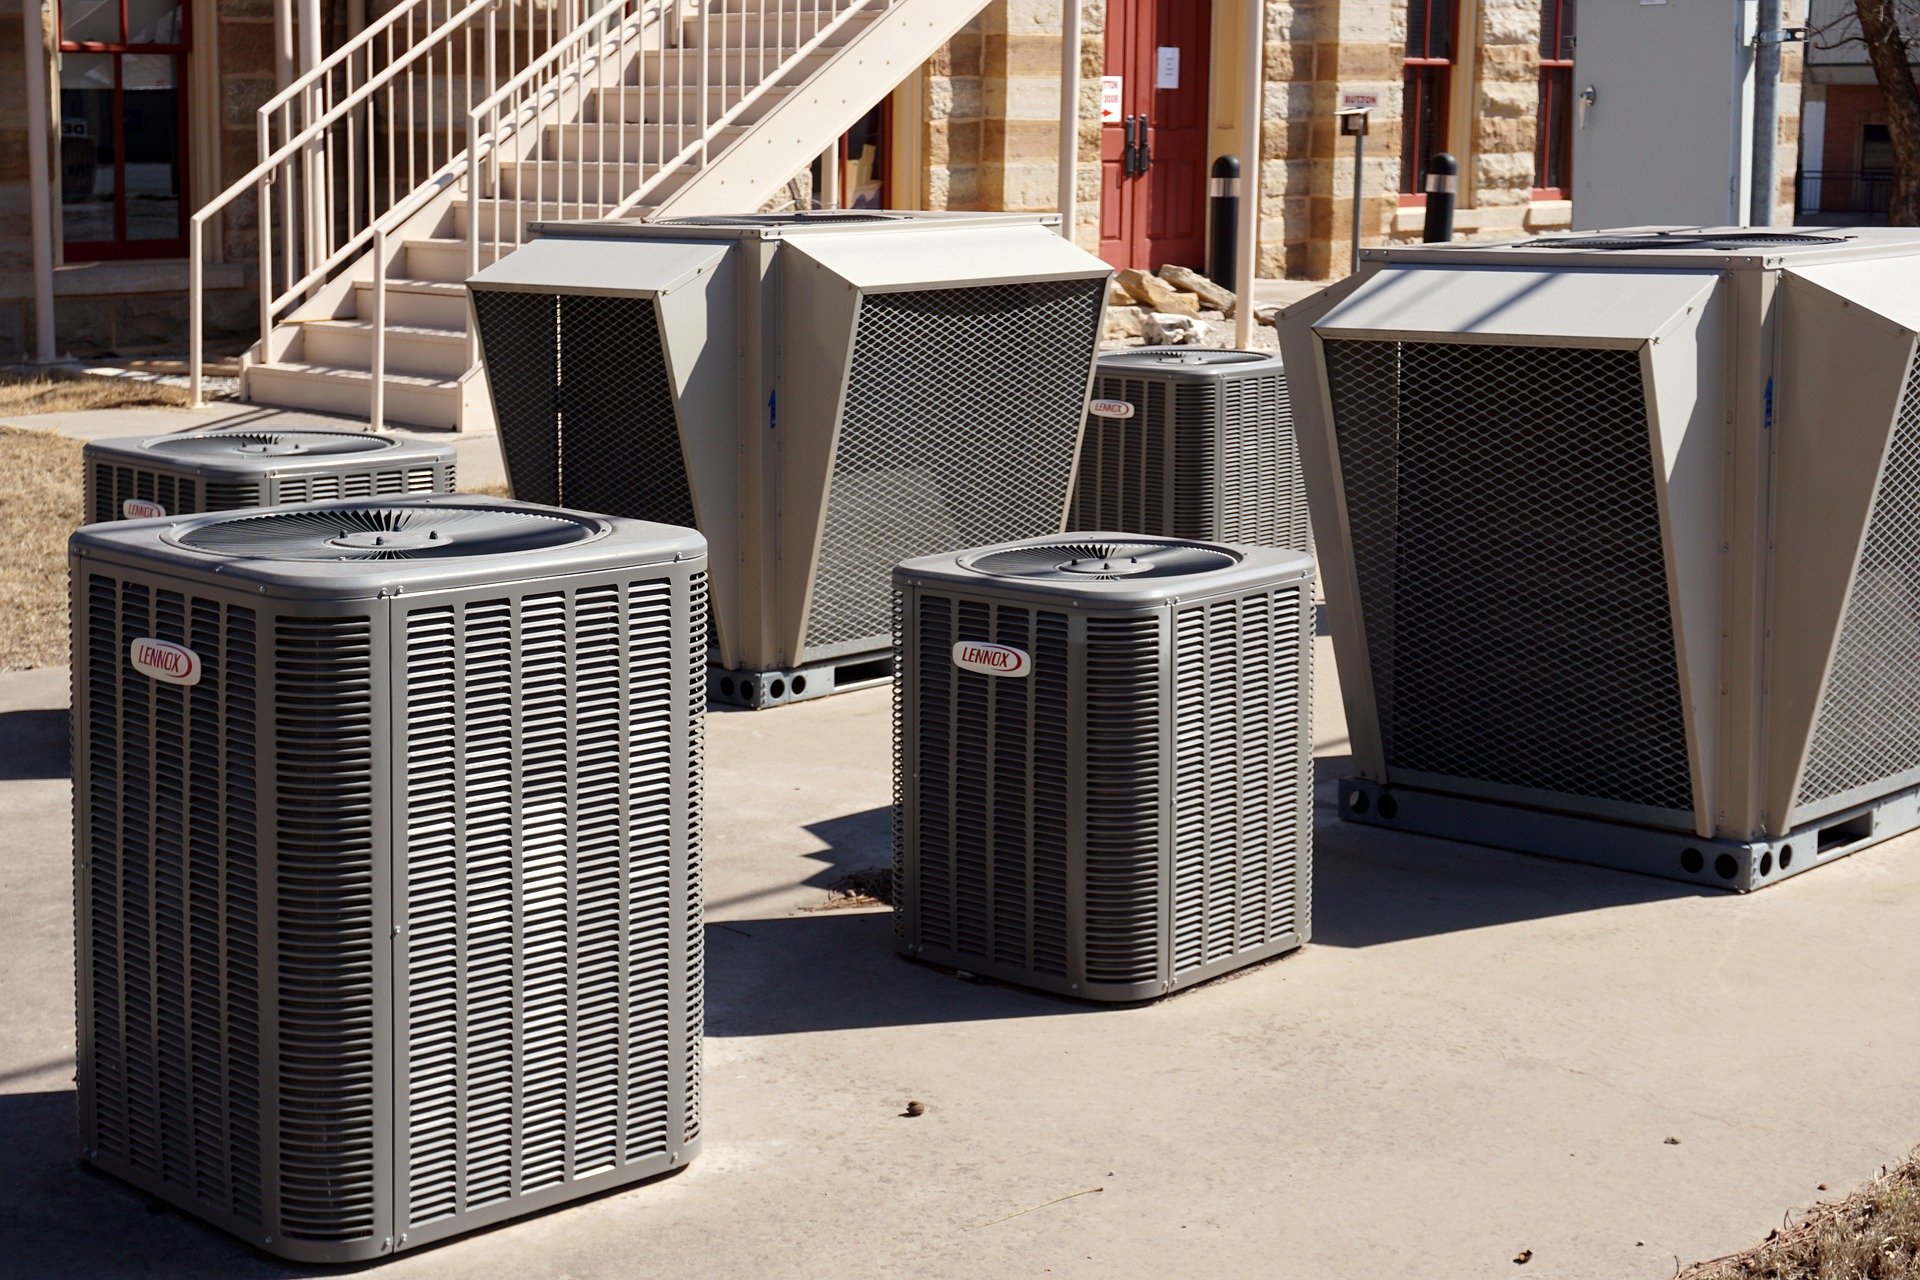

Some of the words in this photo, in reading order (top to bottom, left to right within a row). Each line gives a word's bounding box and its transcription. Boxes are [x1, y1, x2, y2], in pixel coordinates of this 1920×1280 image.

[1343, 95, 1377, 104] BUTTON
[1095, 402, 1121, 413] LENNOX
[128, 504, 153, 517] LENNOX
[138, 645, 181, 673] LENNOX
[962, 647, 1010, 668] LENNOX
